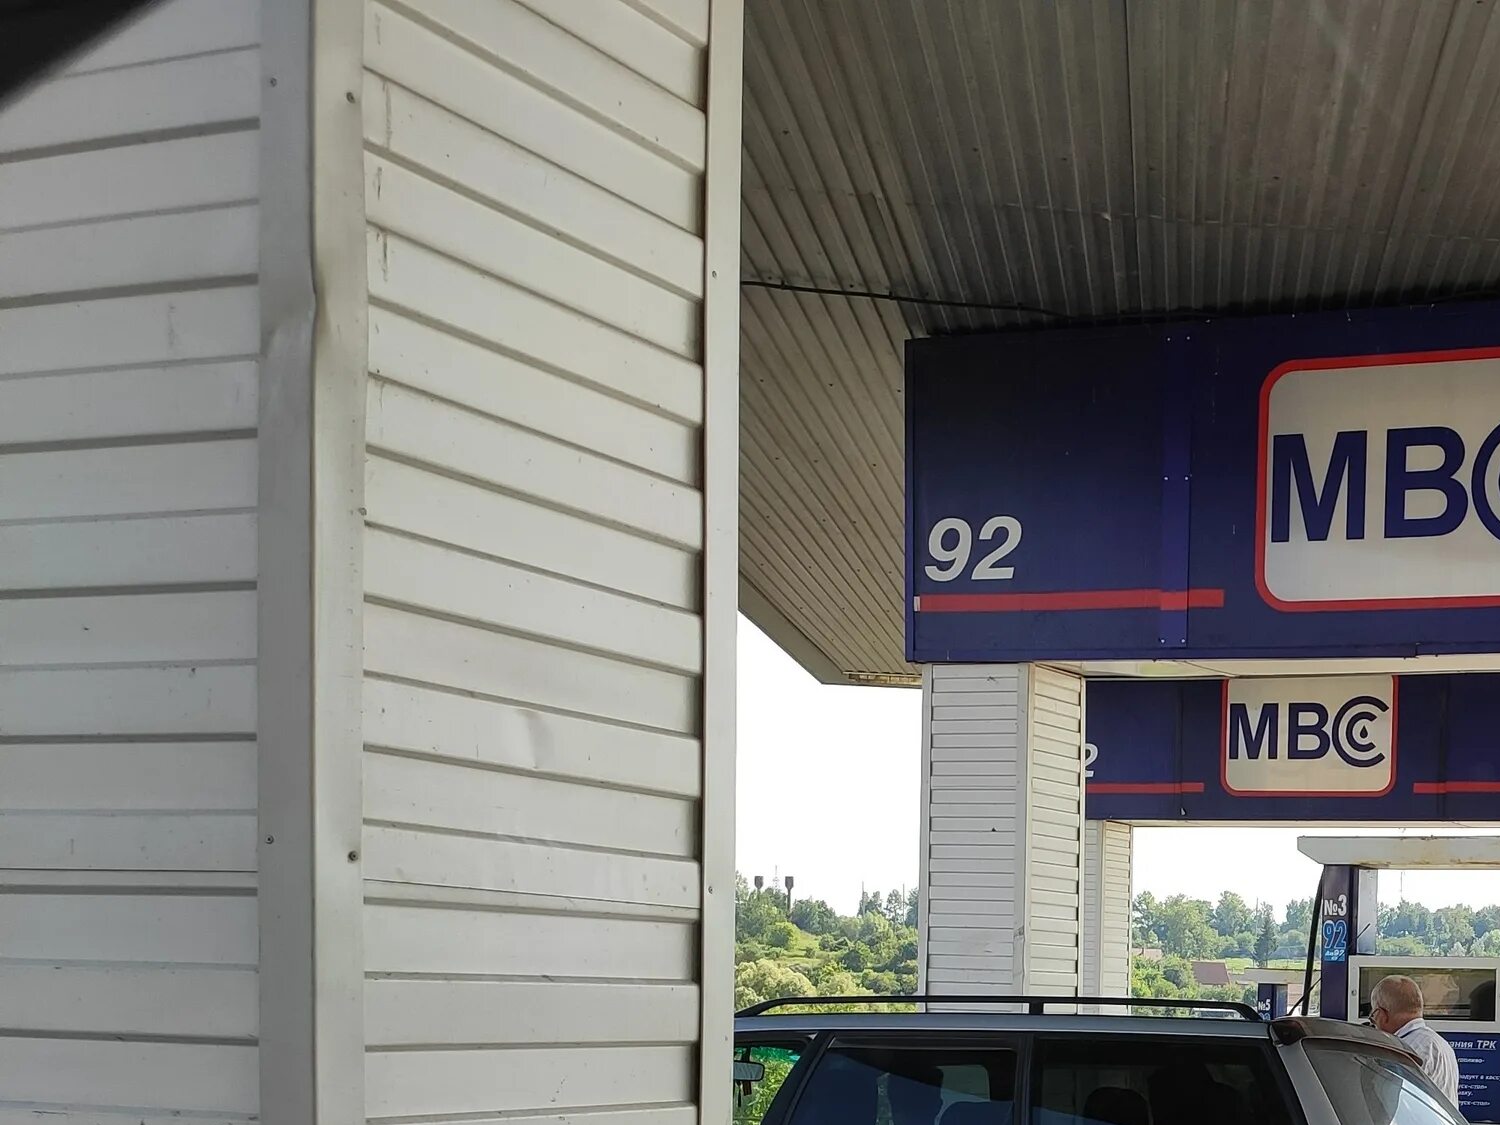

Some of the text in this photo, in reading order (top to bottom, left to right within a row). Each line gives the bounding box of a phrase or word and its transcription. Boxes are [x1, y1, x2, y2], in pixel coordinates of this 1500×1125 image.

[924, 515, 1023, 582] 92
[1323, 894, 1348, 917] №3
[1322, 919, 1348, 950] 92
[1476, 1040, 1498, 1050] ТРК
